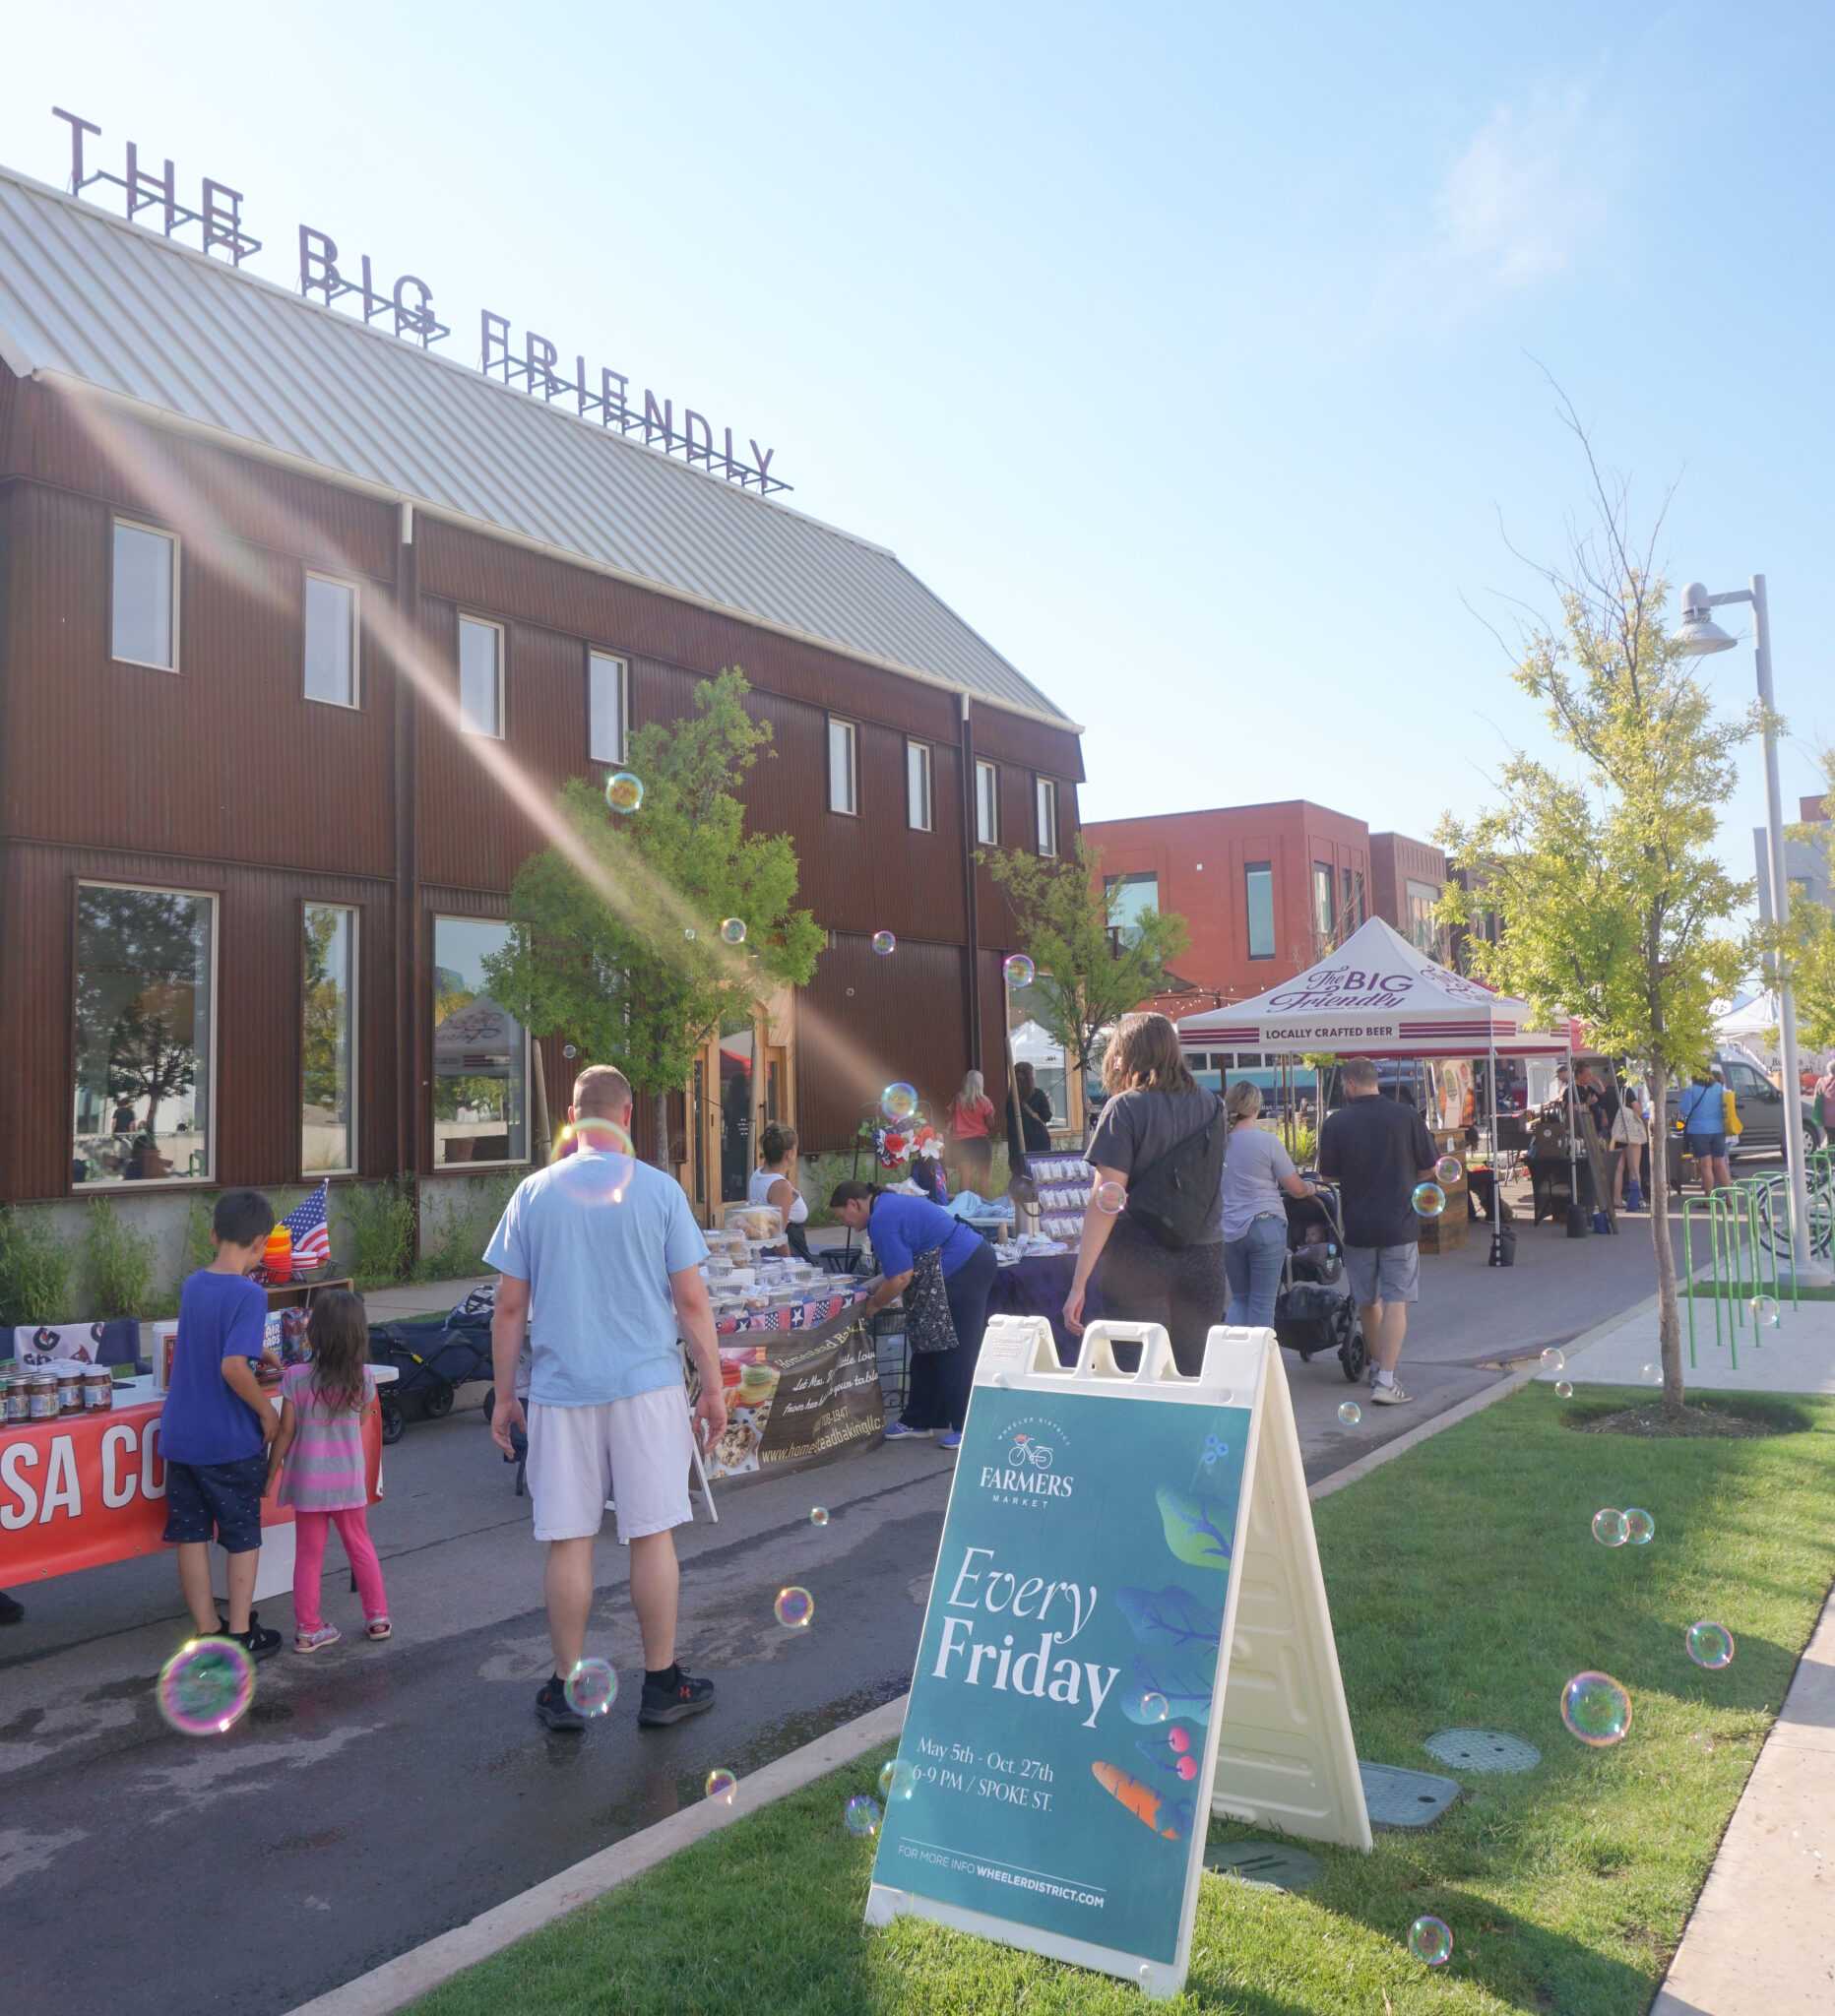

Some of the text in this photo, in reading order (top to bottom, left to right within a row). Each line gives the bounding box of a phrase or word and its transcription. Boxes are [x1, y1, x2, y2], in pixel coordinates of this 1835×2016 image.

[51, 105, 775, 489] THE BIG FRIENDLY
[1266, 985, 1406, 1013] Friendly
[1306, 965, 1349, 990] The
[1343, 971, 1415, 992] BIG
[1266, 1026, 1393, 1040] LOCALLY CRAFTED BEER
[980, 1464, 1074, 1497] FARMERS
[992, 1494, 1048, 1509] MARKET
[946, 1546, 1098, 1645] Every
[931, 1615, 1121, 1730] Friday
[916, 1735, 947, 1763] May
[949, 1742, 975, 1765] 5th
[986, 1750, 1016, 1774] Oct.
[1019, 1757, 1054, 1783] 27th
[912, 1763, 937, 1784] 6-9
[939, 1768, 964, 1792] PM
[977, 1777, 1030, 1807] SPOKE
[1031, 1790, 1053, 1812] ST.
[898, 1844, 1106, 1909] FOR MORE INFO WHEELERDISTRICT.COM
